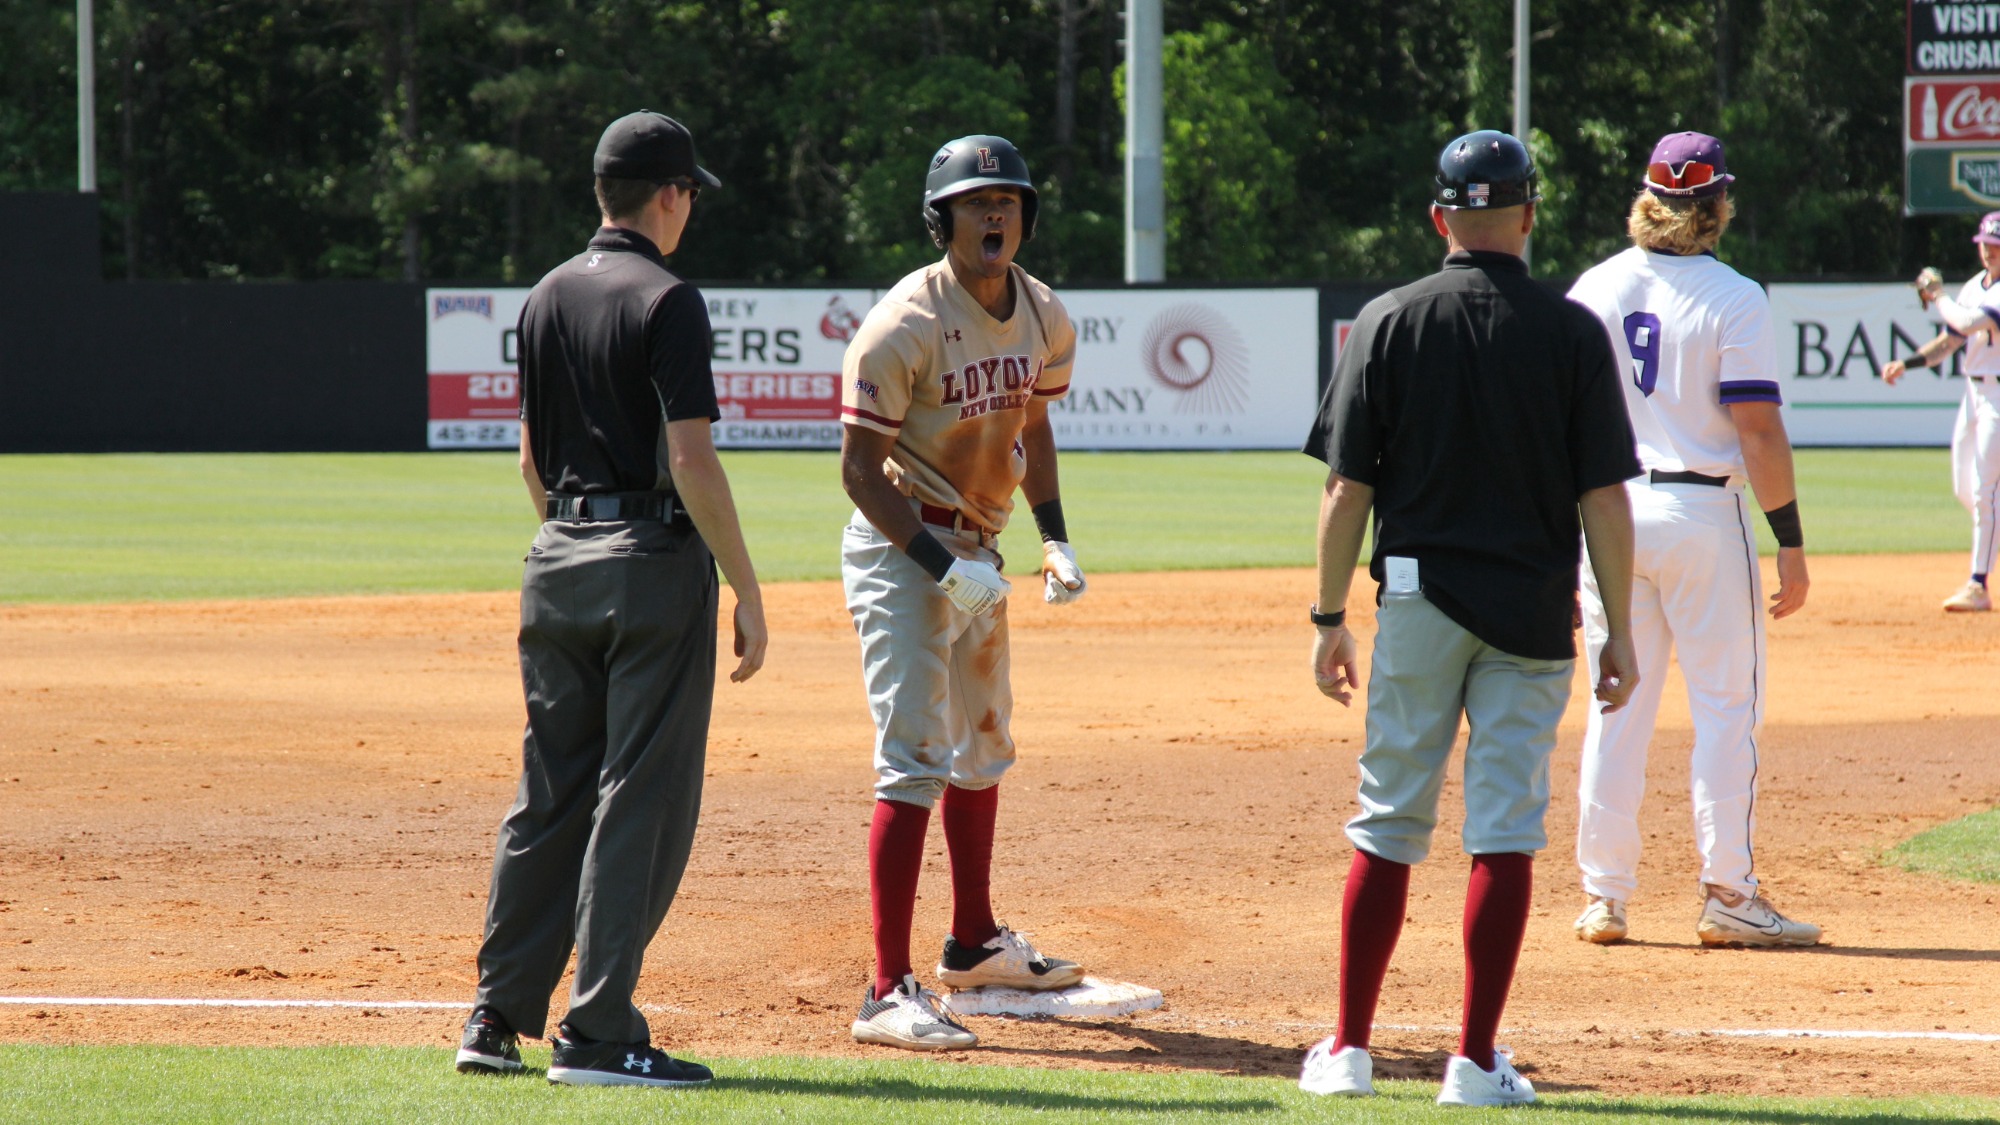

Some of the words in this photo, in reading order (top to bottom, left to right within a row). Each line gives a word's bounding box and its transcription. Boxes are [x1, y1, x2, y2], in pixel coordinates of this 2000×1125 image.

[976, 147, 1000, 172] L
[1624, 311, 1661, 397] 9
[958, 398, 988, 422] NEW
